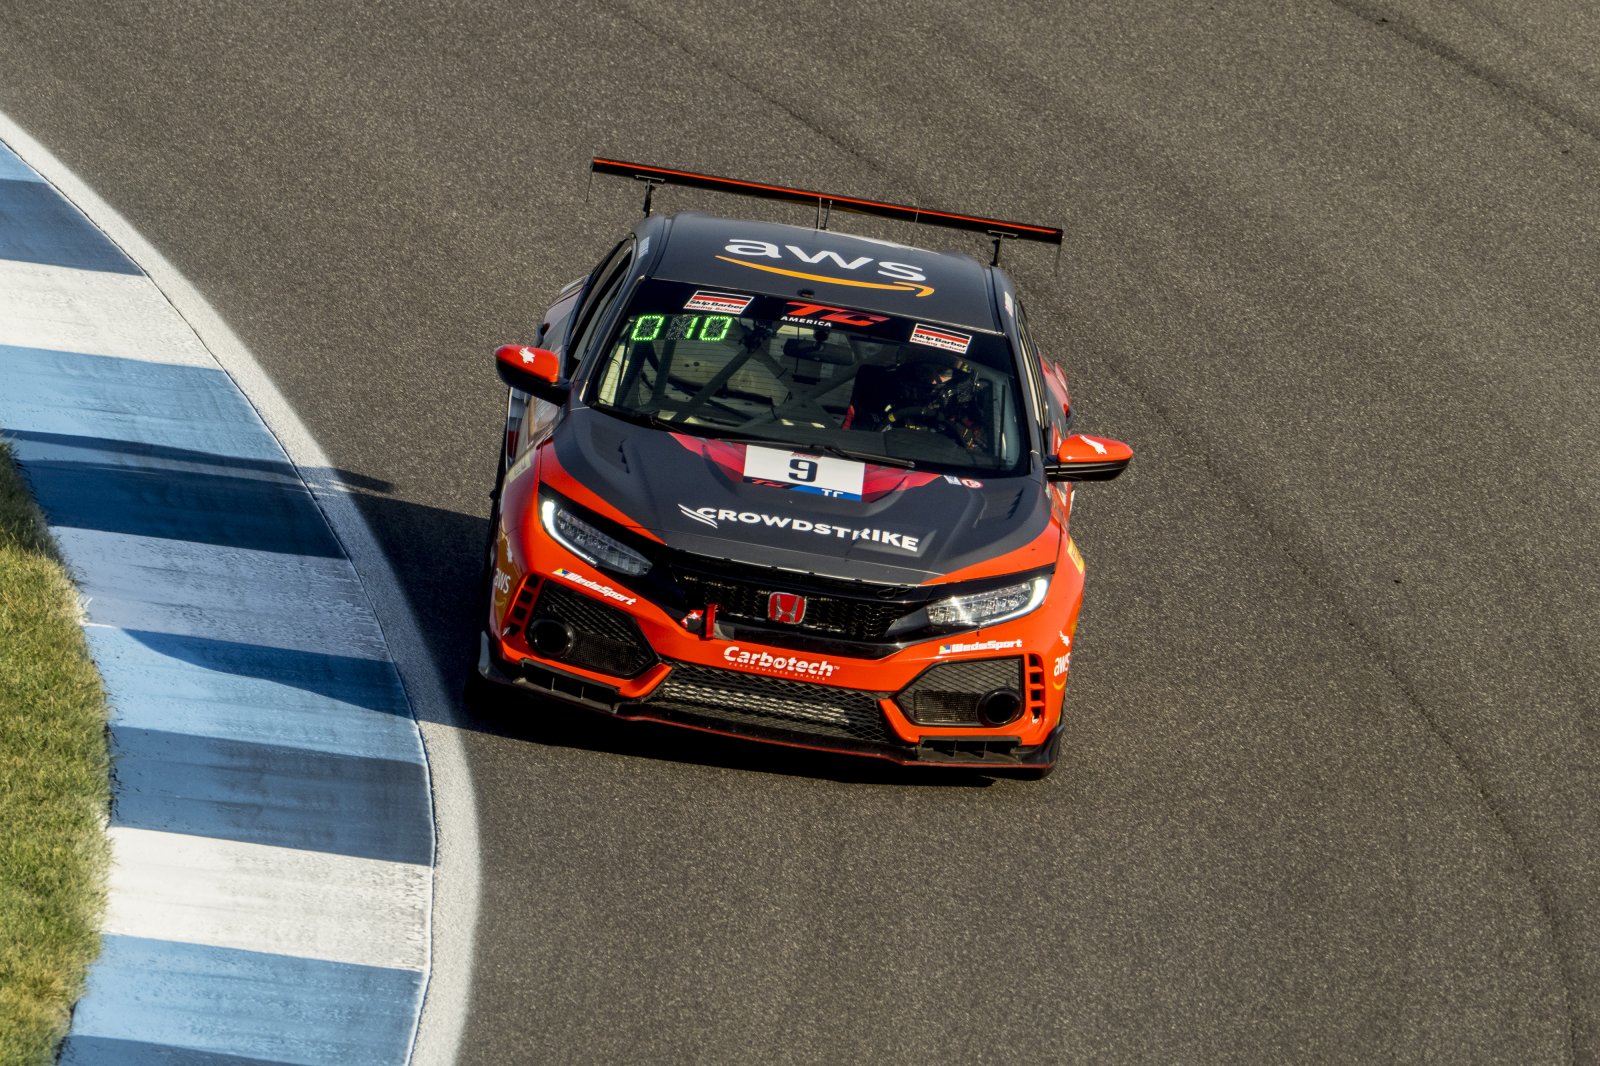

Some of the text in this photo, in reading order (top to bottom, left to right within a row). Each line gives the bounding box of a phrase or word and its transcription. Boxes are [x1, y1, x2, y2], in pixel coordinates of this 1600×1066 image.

[724, 238, 927, 282] aws
[711, 301, 744, 310] Barber
[780, 315, 833, 328] AMERICA
[913, 333, 967, 349] Skip Barber
[788, 458, 819, 483] 9
[696, 507, 920, 552] CROWDSTRIKE
[494, 567, 511, 594] aws
[1053, 652, 1071, 677] aws
